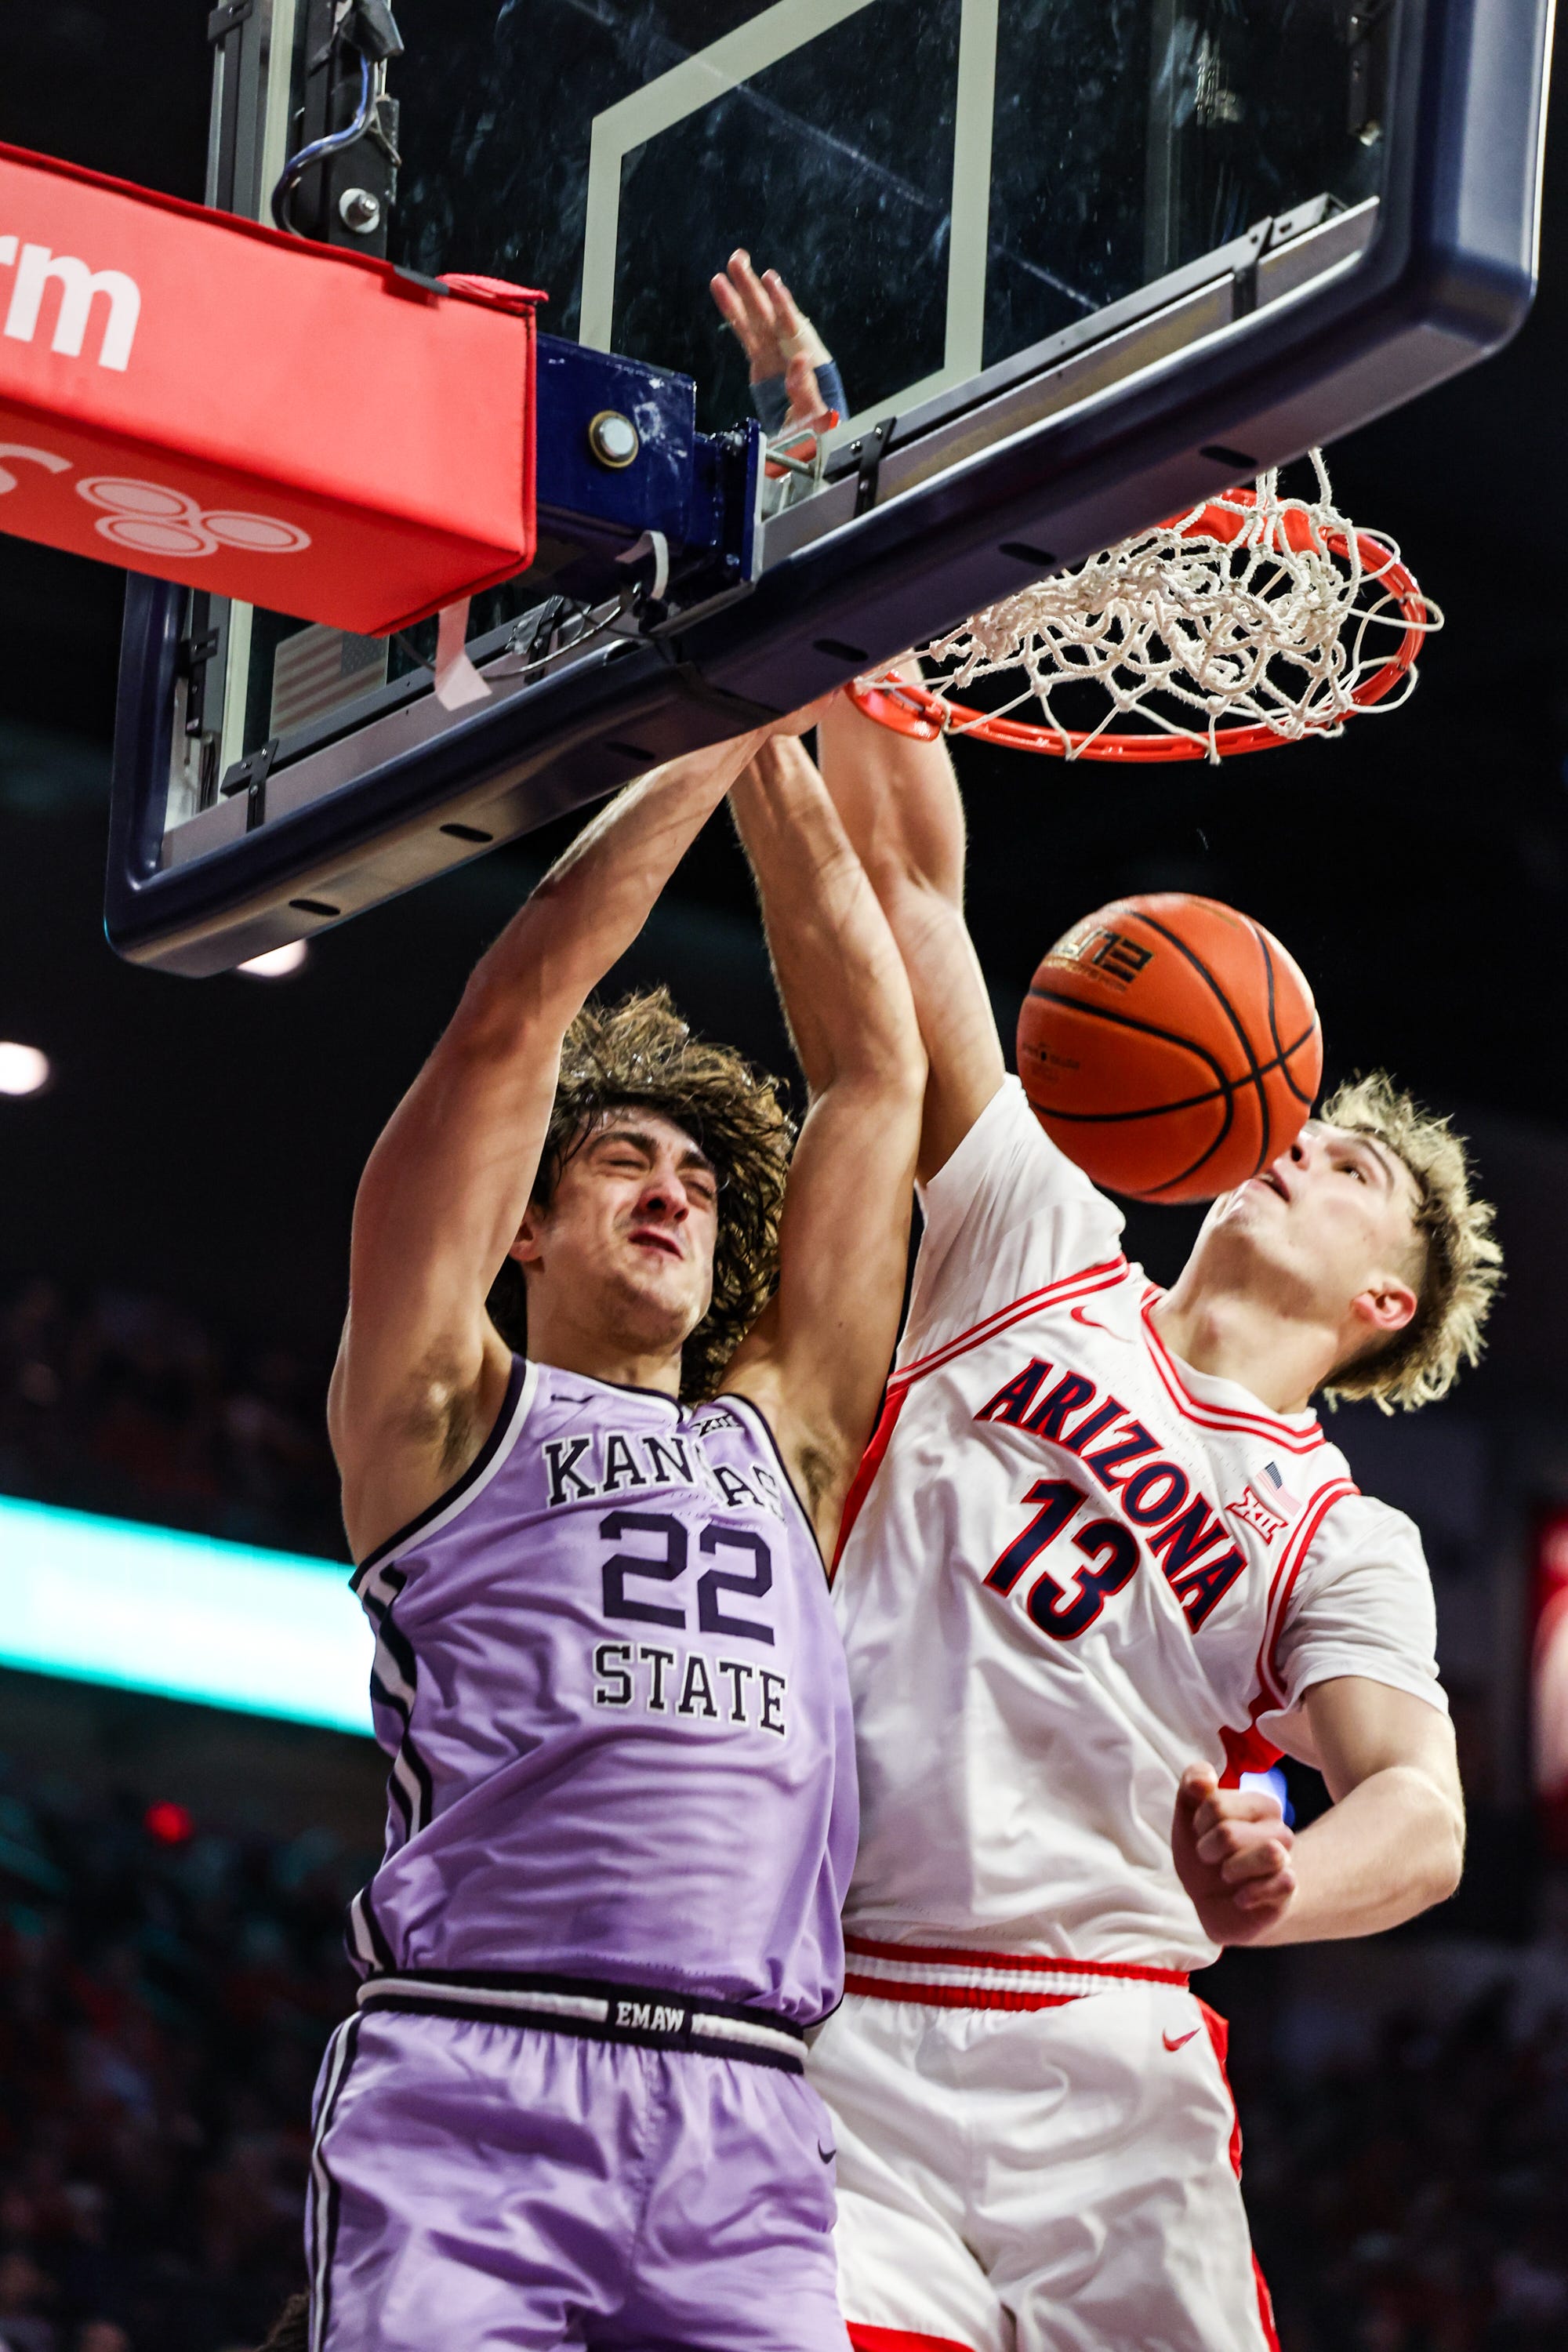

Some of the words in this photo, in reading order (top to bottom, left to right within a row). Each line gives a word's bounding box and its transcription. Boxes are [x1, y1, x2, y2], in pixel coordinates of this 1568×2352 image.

[973, 1356, 1248, 1635] ARIZONA
[982, 1479, 1141, 1641] 13
[599, 1511, 775, 1646] 22
[593, 1641, 787, 1740] STATE
[615, 2001, 685, 2032] EMAW
